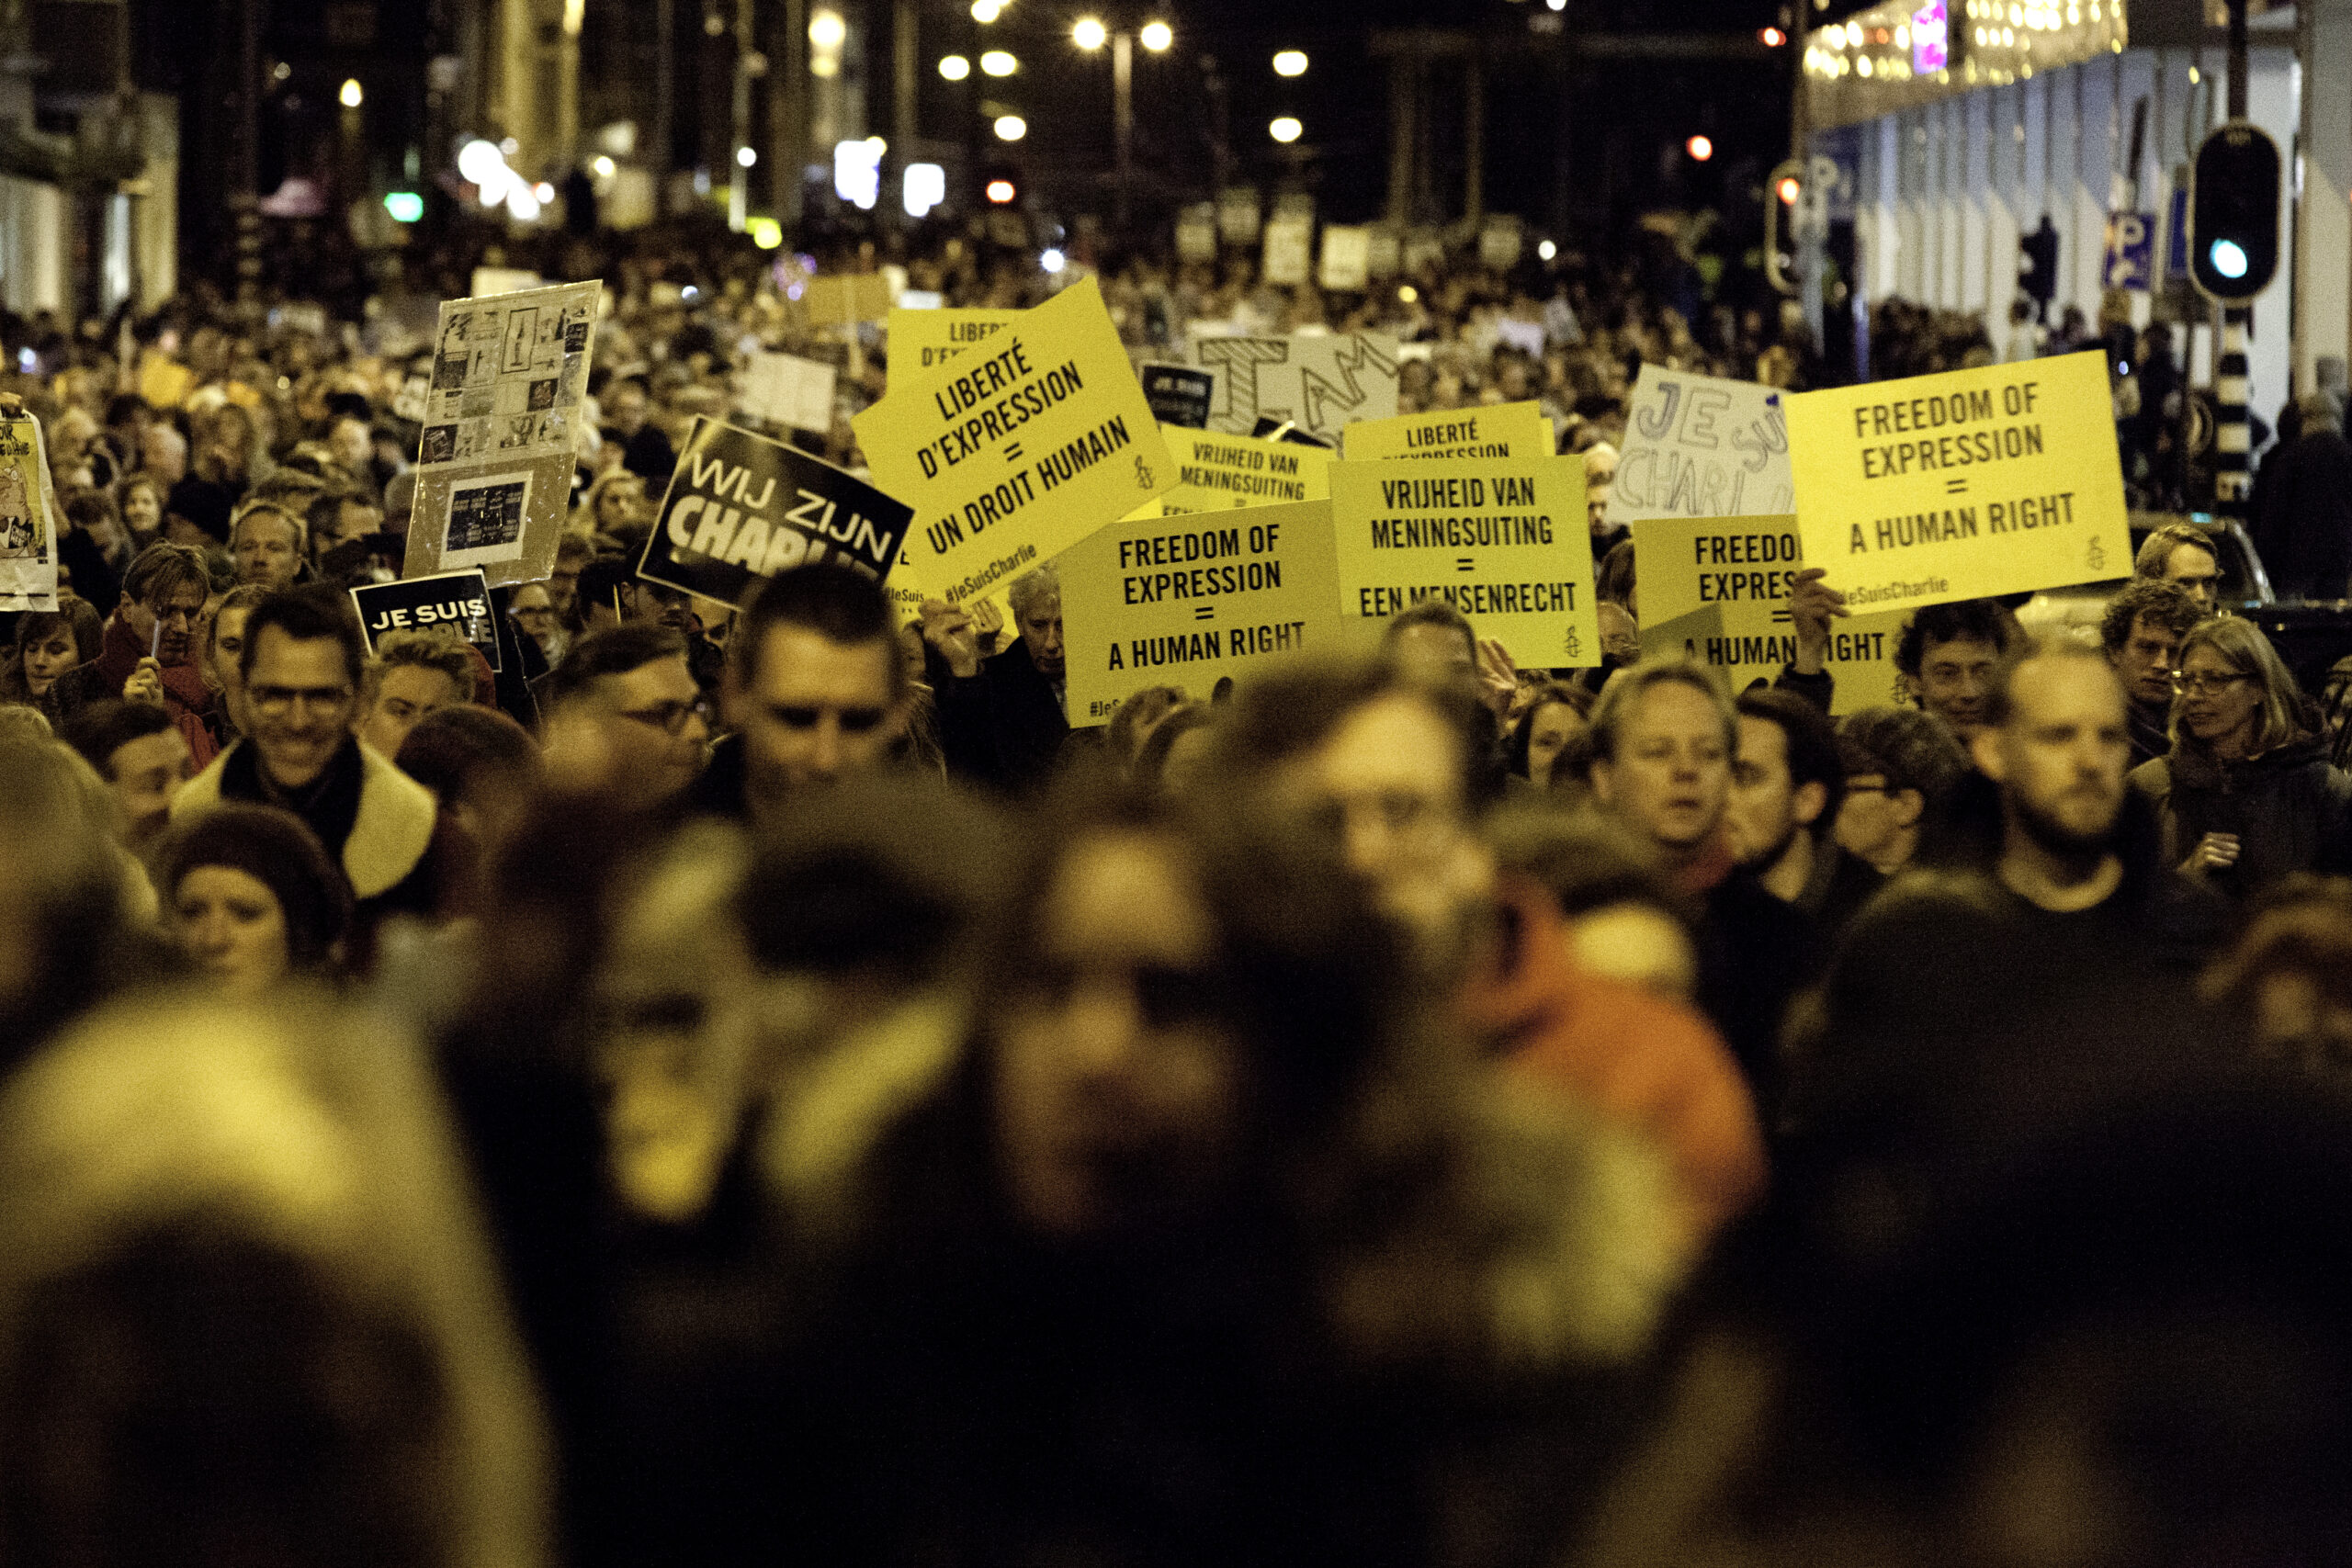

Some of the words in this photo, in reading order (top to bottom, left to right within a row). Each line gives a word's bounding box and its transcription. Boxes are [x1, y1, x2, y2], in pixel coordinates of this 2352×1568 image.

[950, 321, 1009, 343] LIBER
[934, 336, 1034, 423] LIBERTÉ
[917, 360, 1084, 479] D'EXPRESSION
[1406, 415, 1480, 448] LIBERTÉ
[1637, 382, 1732, 450] JE
[1854, 389, 1994, 439] FREEDOM
[2003, 382, 2039, 417] OF
[1193, 441, 1265, 471] VRIJHEID
[1268, 453, 1300, 476] VAN
[1861, 423, 2044, 480] EXPRESSION
[926, 517, 965, 556] UN
[964, 470, 1035, 535] DROIT
[1036, 413, 1132, 492] HUMAIN
[1181, 465, 1306, 501] MENINGSUITING
[1381, 478, 1485, 510] VRIJHEID
[1491, 477, 1536, 507] VAN
[692, 452, 777, 510] WIJ
[785, 488, 893, 563] ZIJN
[1849, 522, 1869, 555] A
[1875, 506, 1979, 551] HUMAN
[1988, 491, 2075, 535] RIGHT
[667, 494, 879, 579] CHAR
[1119, 528, 1241, 570] FREEDOM
[1249, 523, 1281, 555] OF
[1371, 515, 1554, 549] MENINGSUITING
[1695, 533, 1803, 565] FREEDO
[944, 544, 1037, 604] #JeSuisCharlie
[1124, 560, 1283, 605] EXPRESSION
[1699, 570, 1796, 602] EXPRES
[371, 608, 413, 630] JE
[415, 599, 488, 623] SUIS
[1360, 586, 1404, 617] EEN
[1108, 642, 1125, 671] A
[1131, 630, 1222, 669] HUMAN
[1229, 621, 1306, 658] RIGHT
[1706, 635, 1797, 665] HUMAN
[1826, 632, 1885, 662] IGHT
